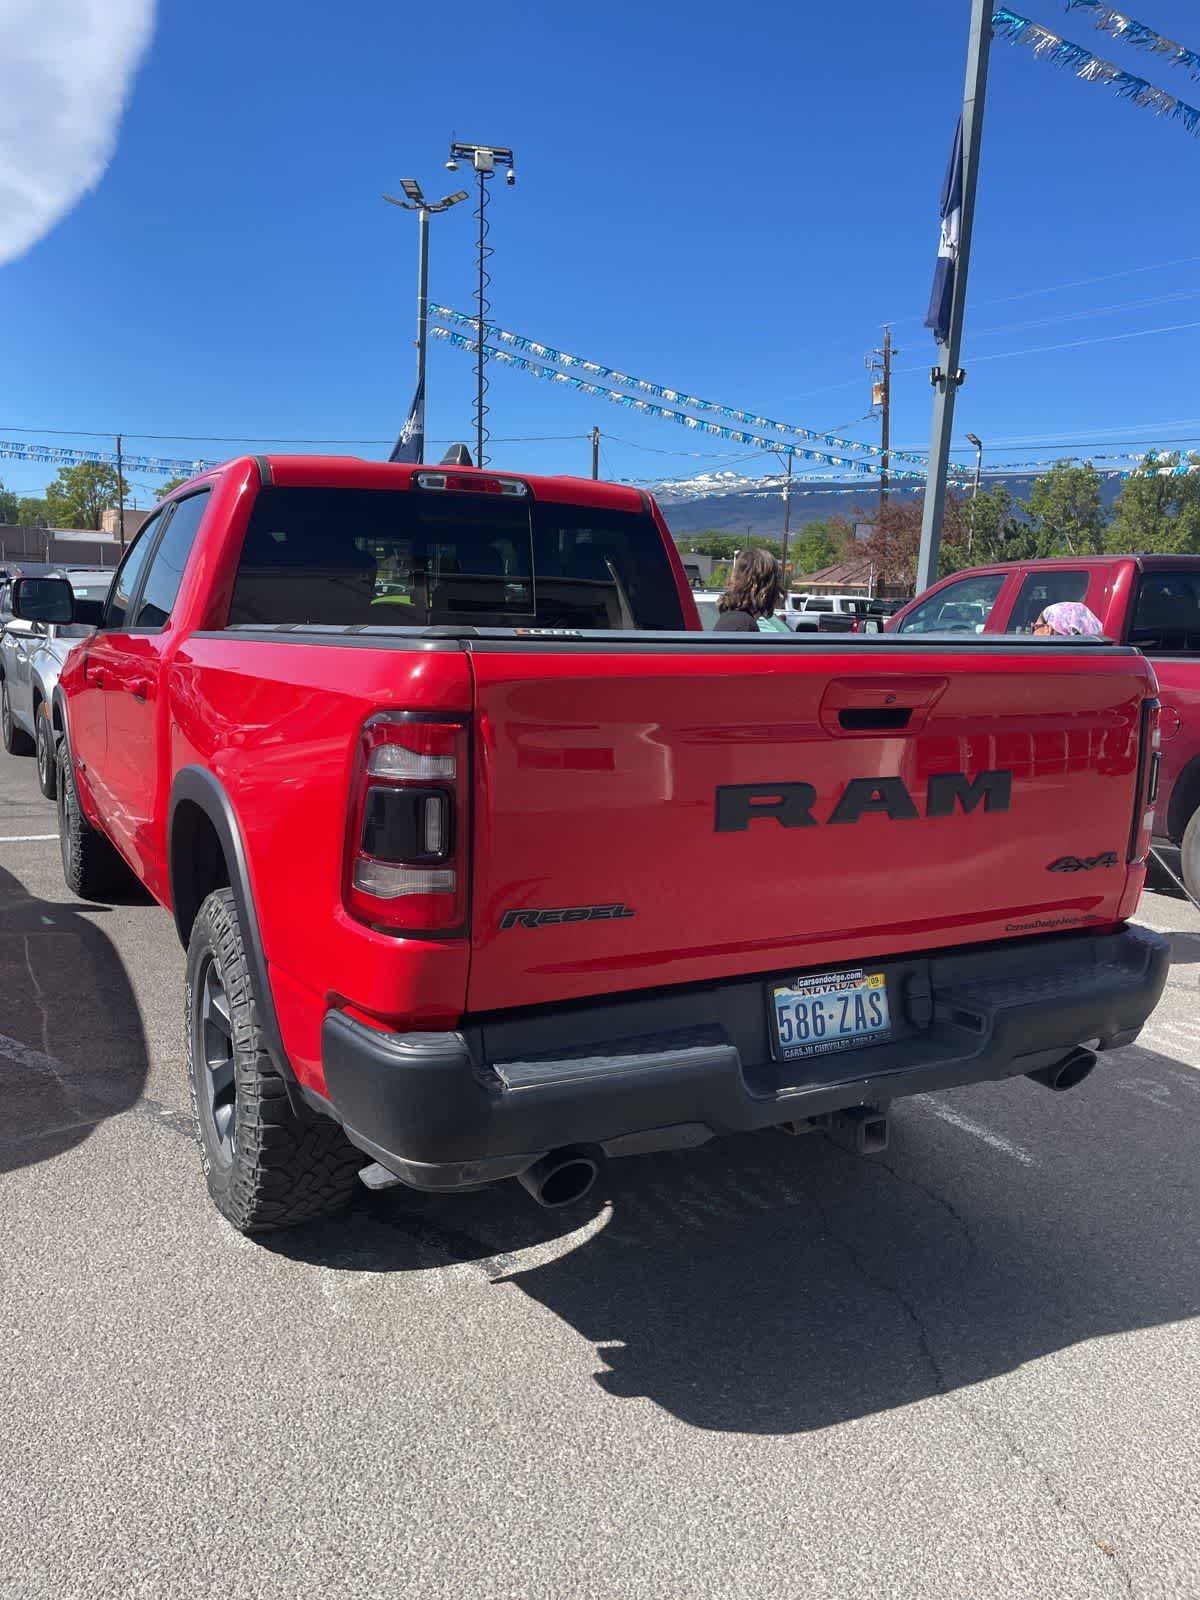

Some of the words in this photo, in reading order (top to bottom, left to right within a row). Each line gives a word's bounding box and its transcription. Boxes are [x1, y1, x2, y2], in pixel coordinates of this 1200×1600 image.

[713, 769, 1012, 832] RAM
[499, 903, 636, 929] REBEL
[799, 971, 862, 988] carsondodge.com
